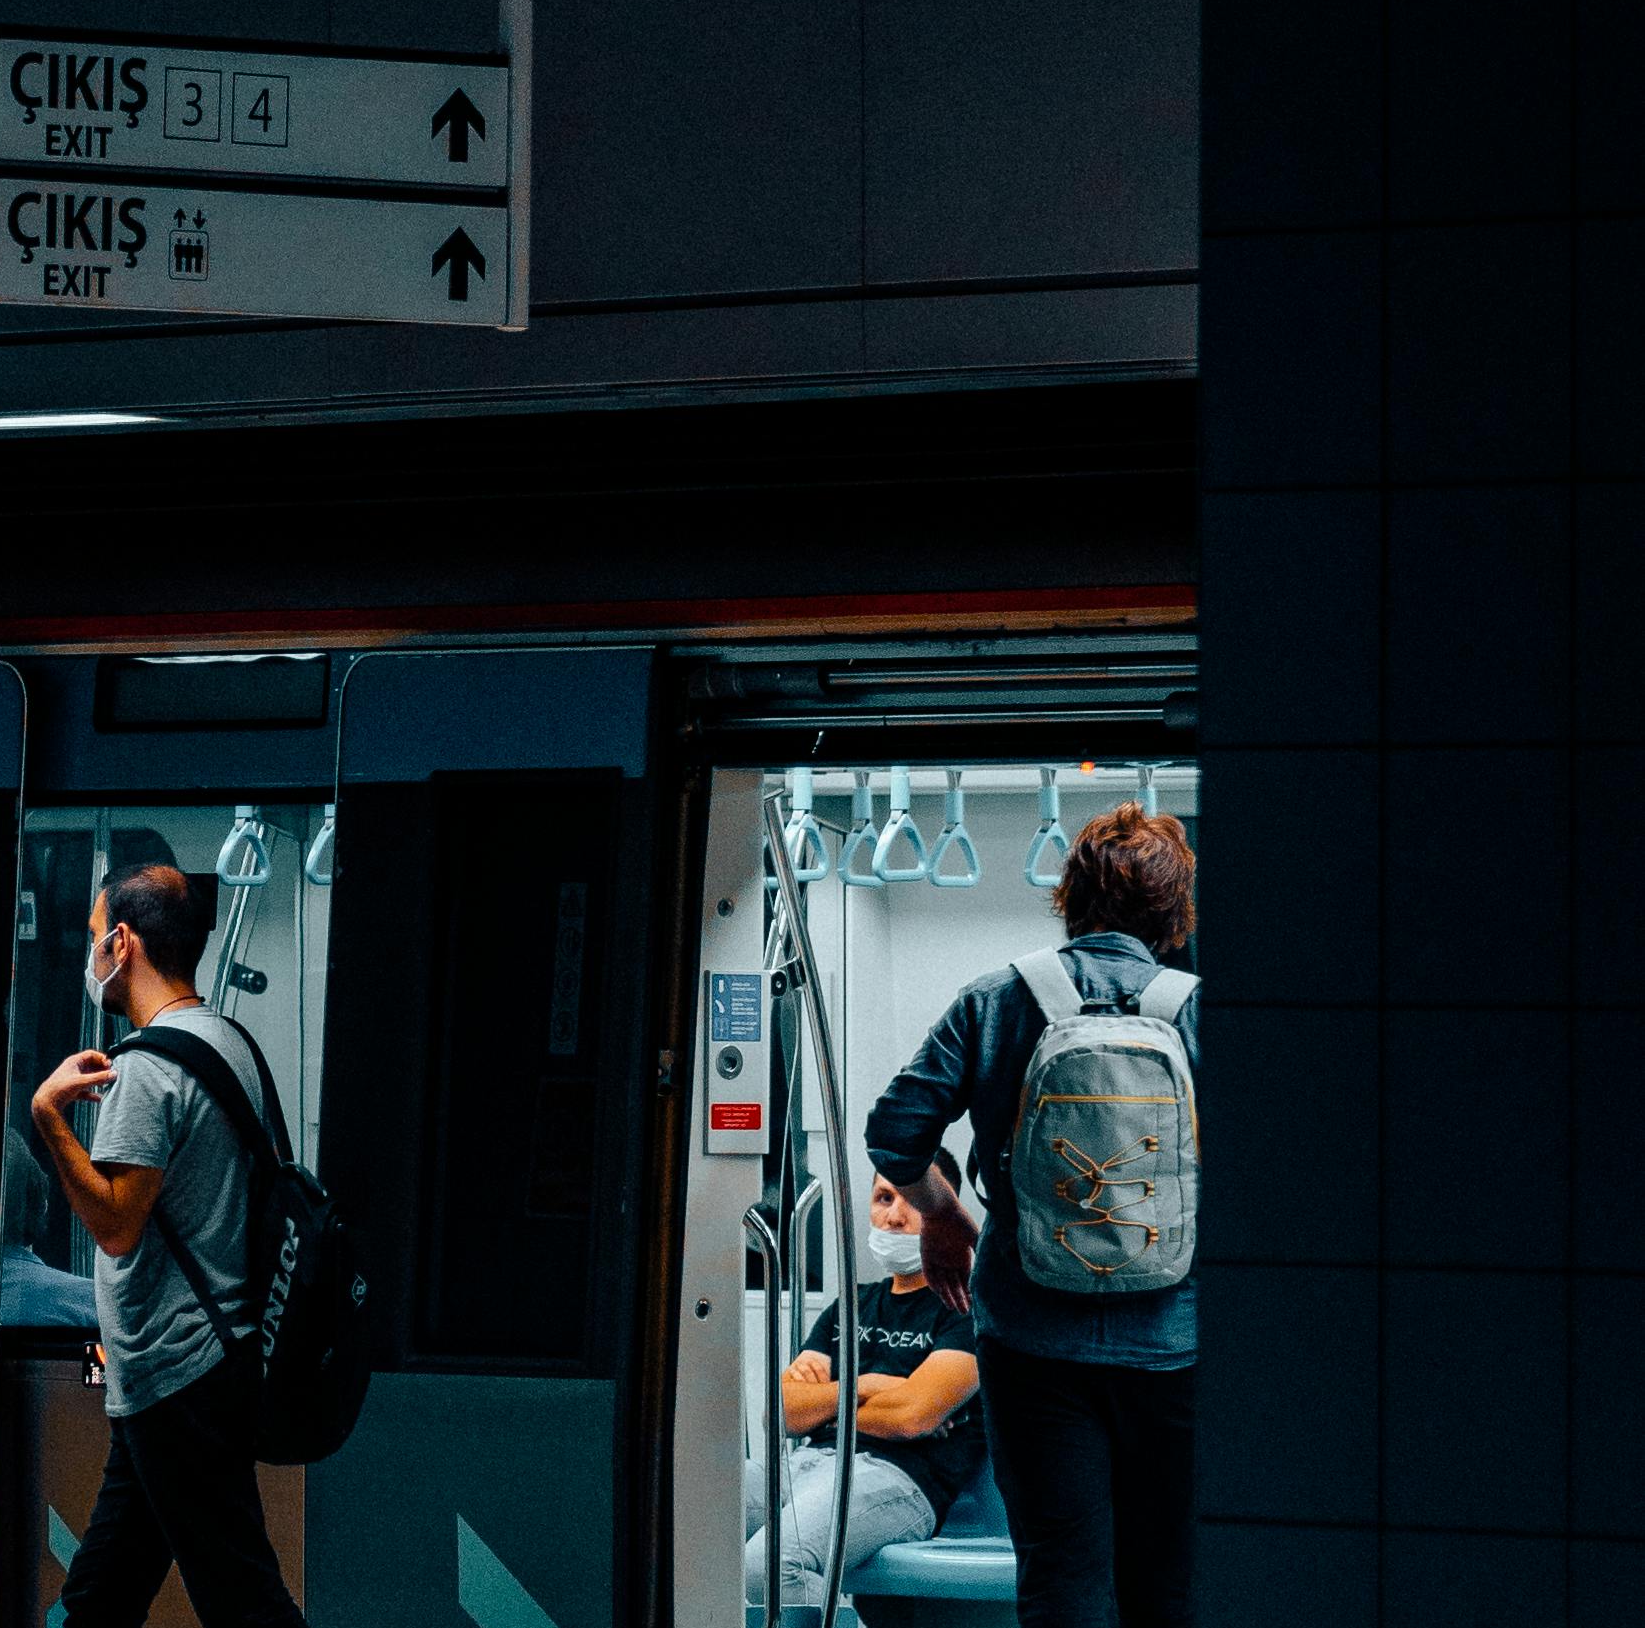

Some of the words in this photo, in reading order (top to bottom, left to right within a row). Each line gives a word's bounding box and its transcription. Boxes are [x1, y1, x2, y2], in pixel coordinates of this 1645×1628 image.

[9, 52, 149, 129] ÇIKIŞ
[181, 82, 204, 127] 3
[247, 88, 274, 133] 4
[44, 123, 114, 159] EXIT
[7, 192, 148, 269] ÇIKIŞ
[42, 263, 112, 299] EXIT
